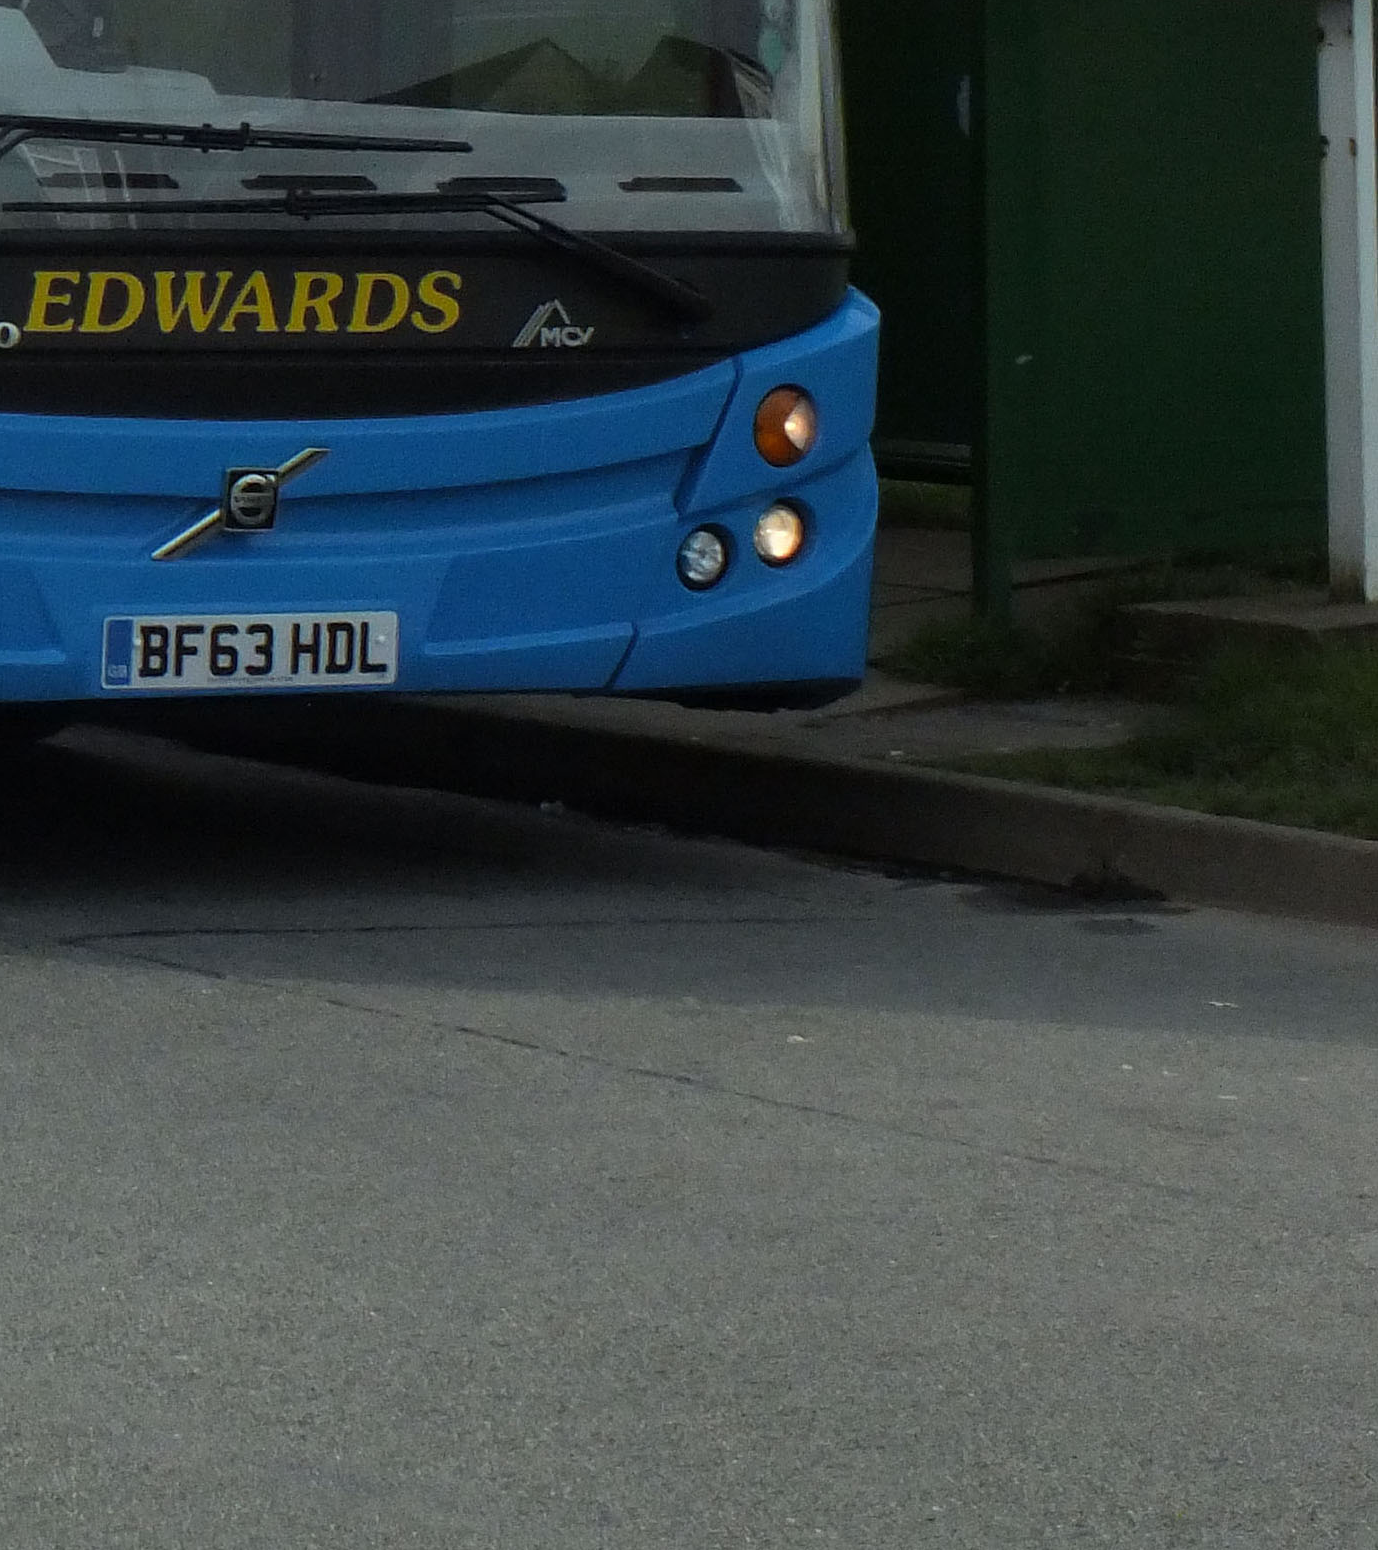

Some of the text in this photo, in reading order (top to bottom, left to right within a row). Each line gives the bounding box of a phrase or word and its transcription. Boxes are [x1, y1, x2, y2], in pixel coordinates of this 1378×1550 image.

[22, 270, 463, 335] EDWARDS
[138, 620, 388, 678] BF63 HDL
